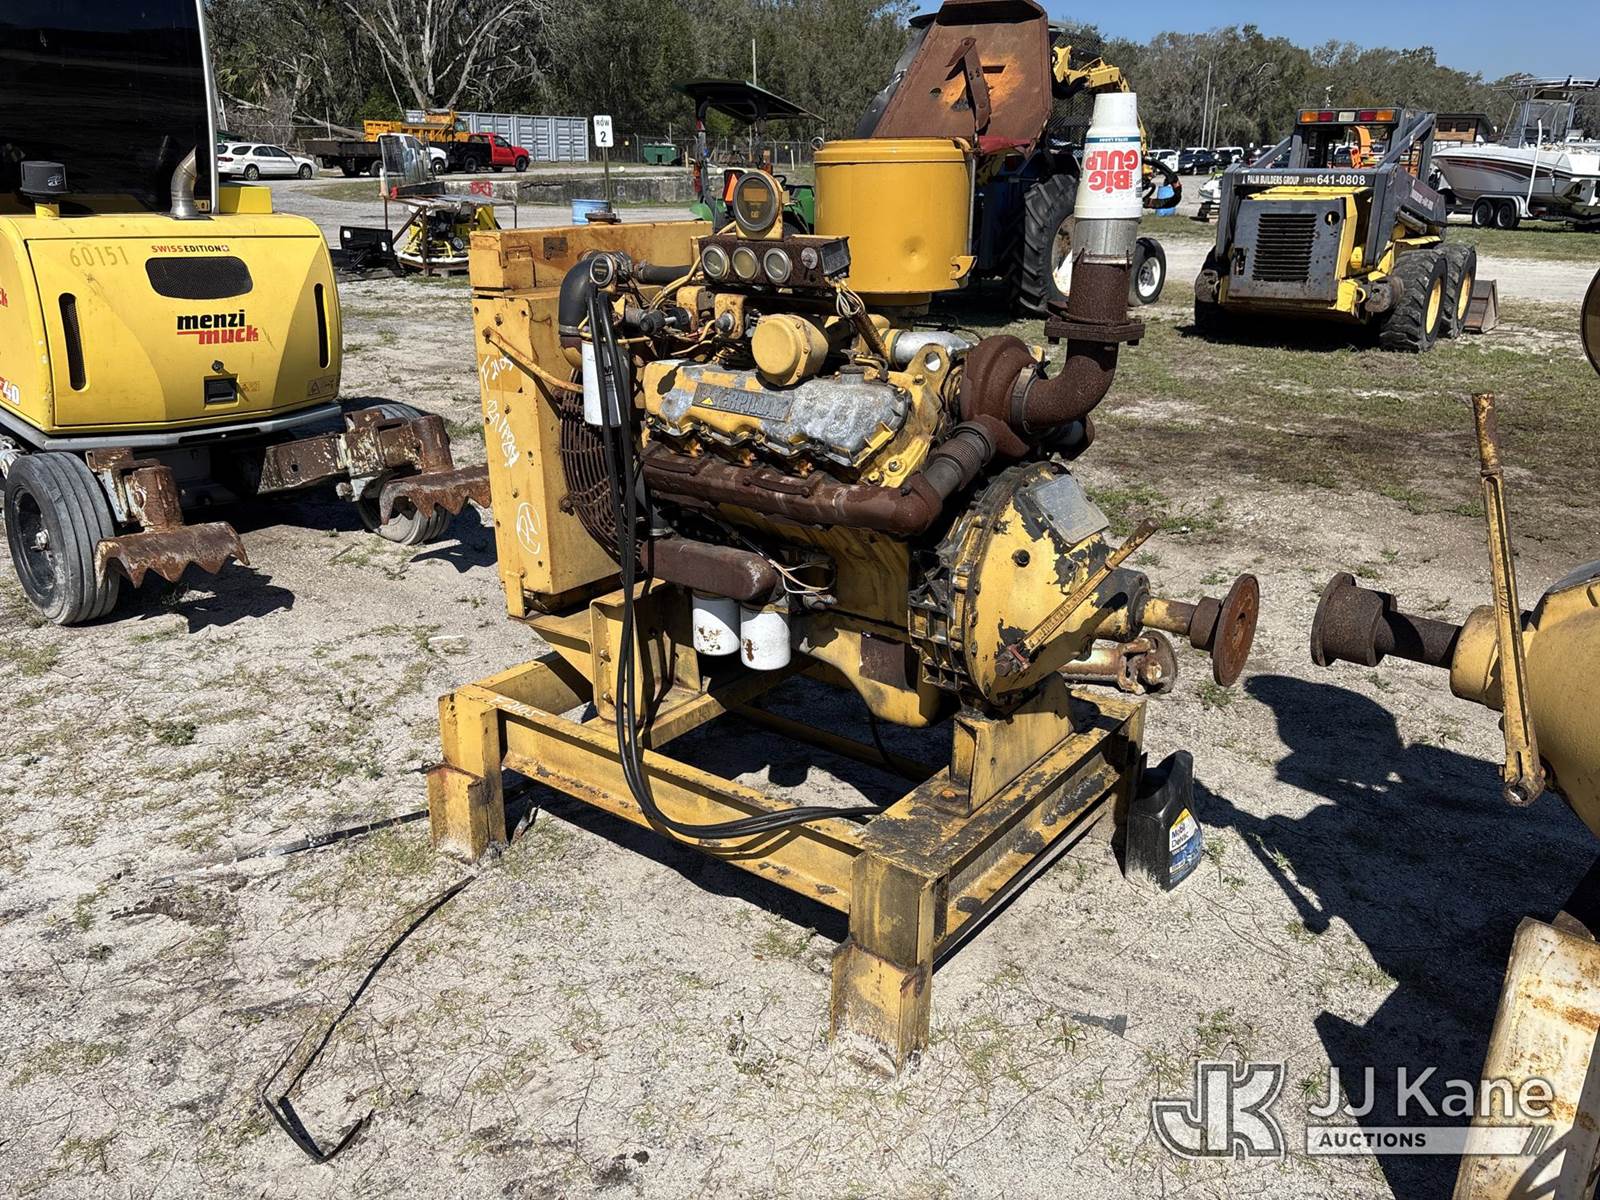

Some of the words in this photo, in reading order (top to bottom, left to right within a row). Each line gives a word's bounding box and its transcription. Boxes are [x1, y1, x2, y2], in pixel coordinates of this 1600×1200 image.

[596, 119, 610, 127] ROW
[600, 131, 607, 142] 2
[1085, 149, 1139, 171] GULP
[1260, 175, 1283, 185] BUILDERS
[1283, 175, 1300, 185] GROUP
[1317, 174, 1366, 185] 641-0808
[69, 245, 130, 268] 60151
[176, 309, 246, 331] menzi
[198, 325, 259, 345] muck
